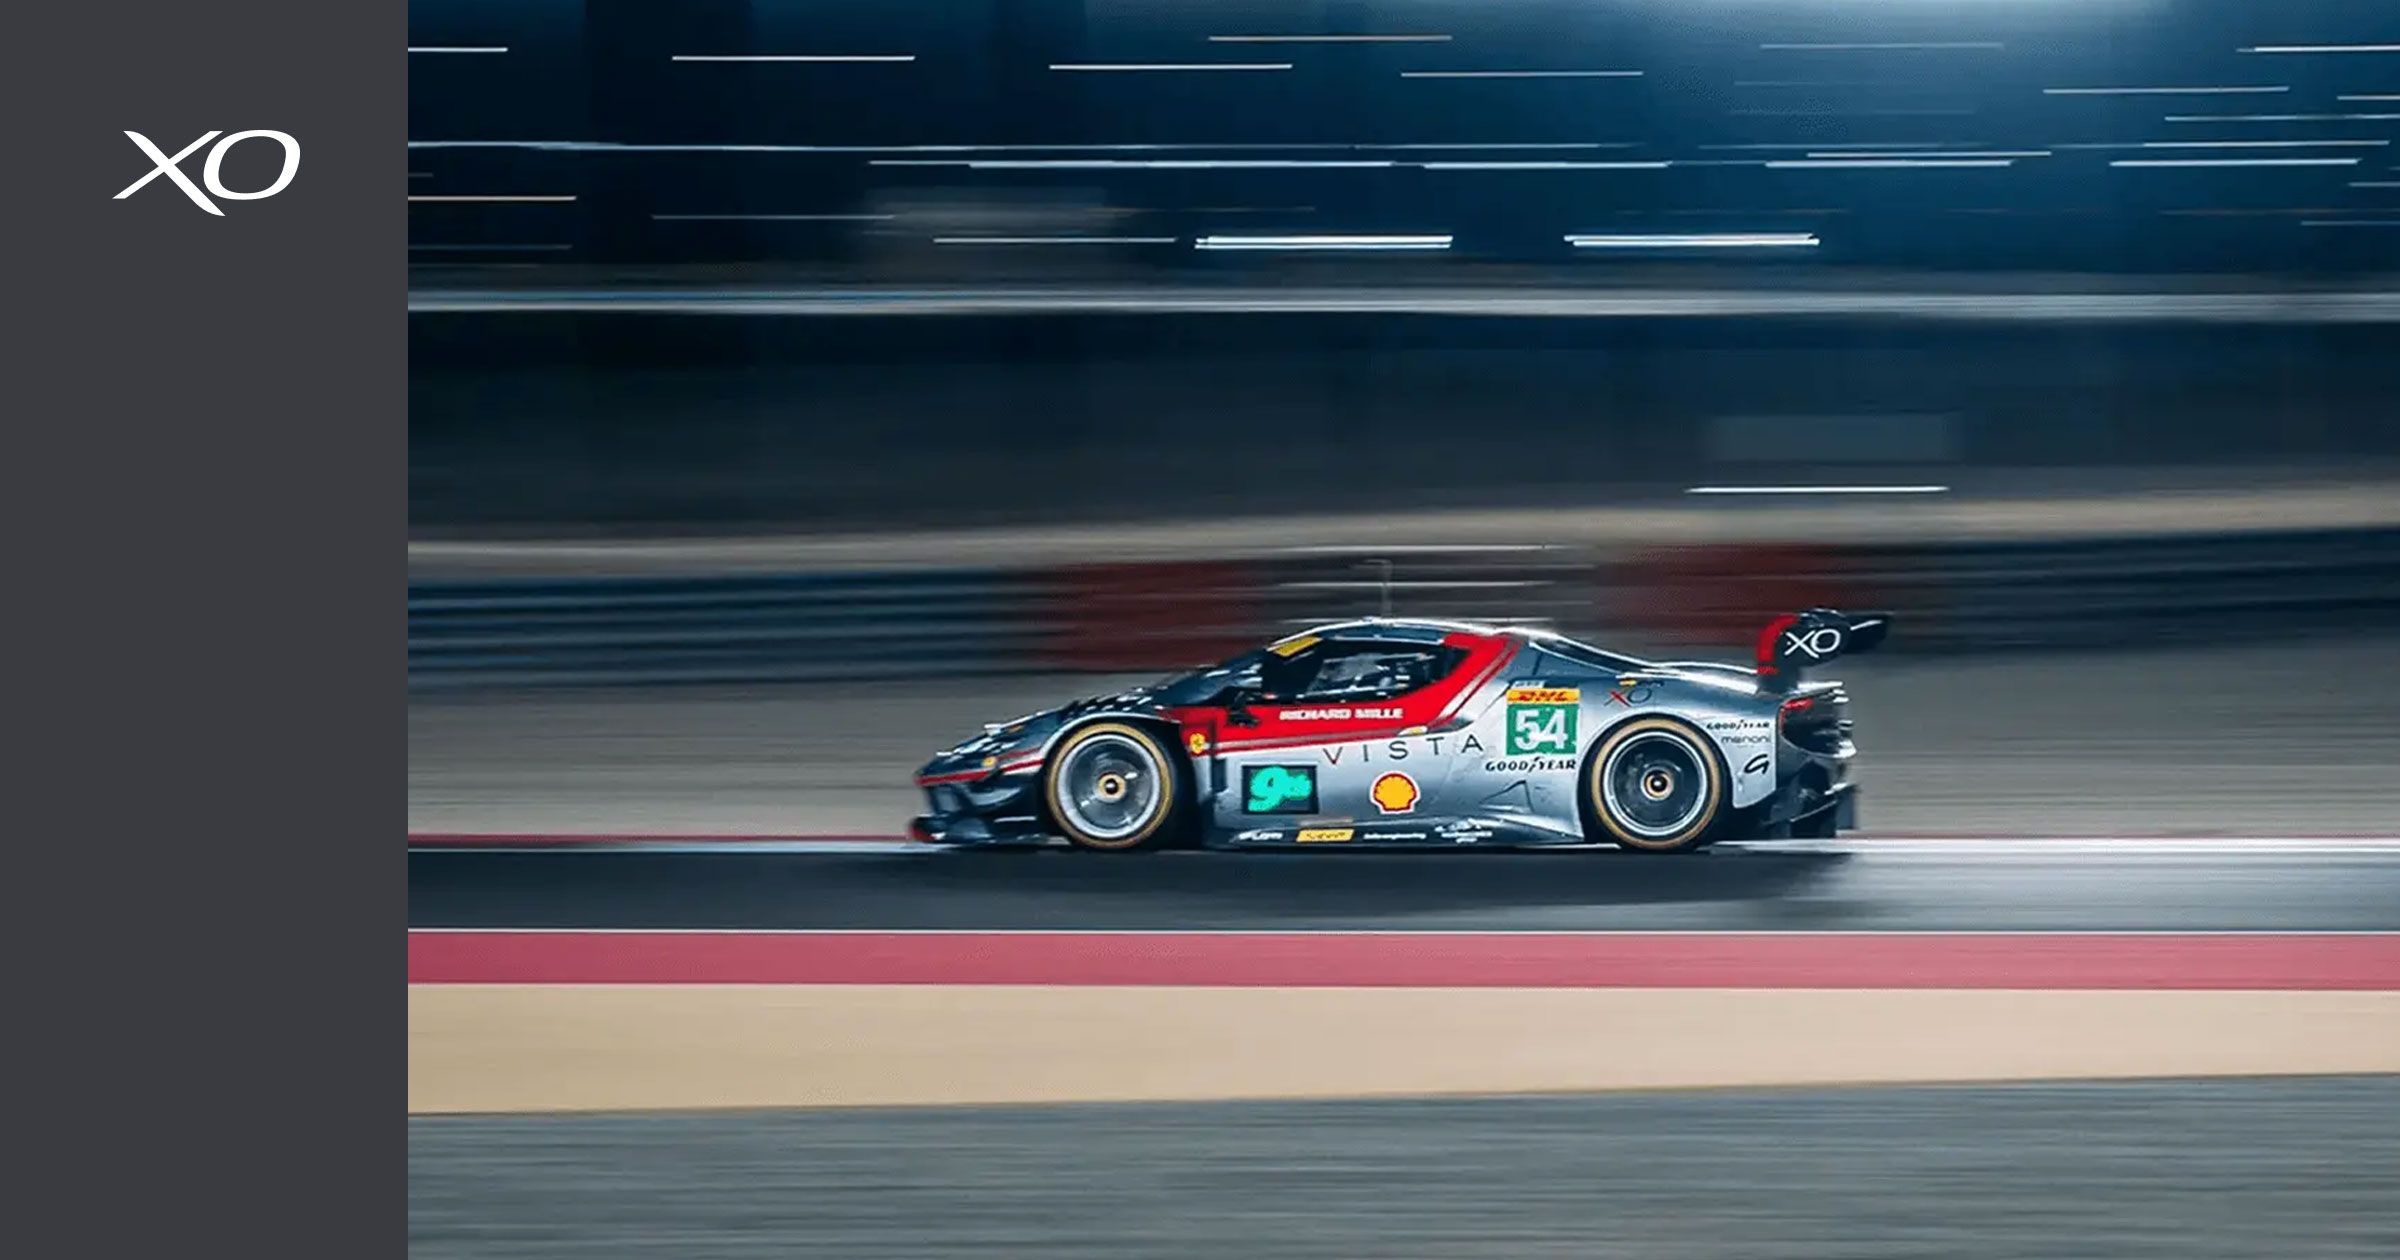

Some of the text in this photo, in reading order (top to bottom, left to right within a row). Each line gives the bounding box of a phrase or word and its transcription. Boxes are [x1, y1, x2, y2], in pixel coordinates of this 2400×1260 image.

[1784, 628, 1841, 658] XO
[1279, 708, 1404, 720] RICHARD MILLE
[1514, 708, 1568, 751] 54
[1322, 733, 1484, 765] VISTA
[1485, 756, 1577, 773] GOODYEAR
